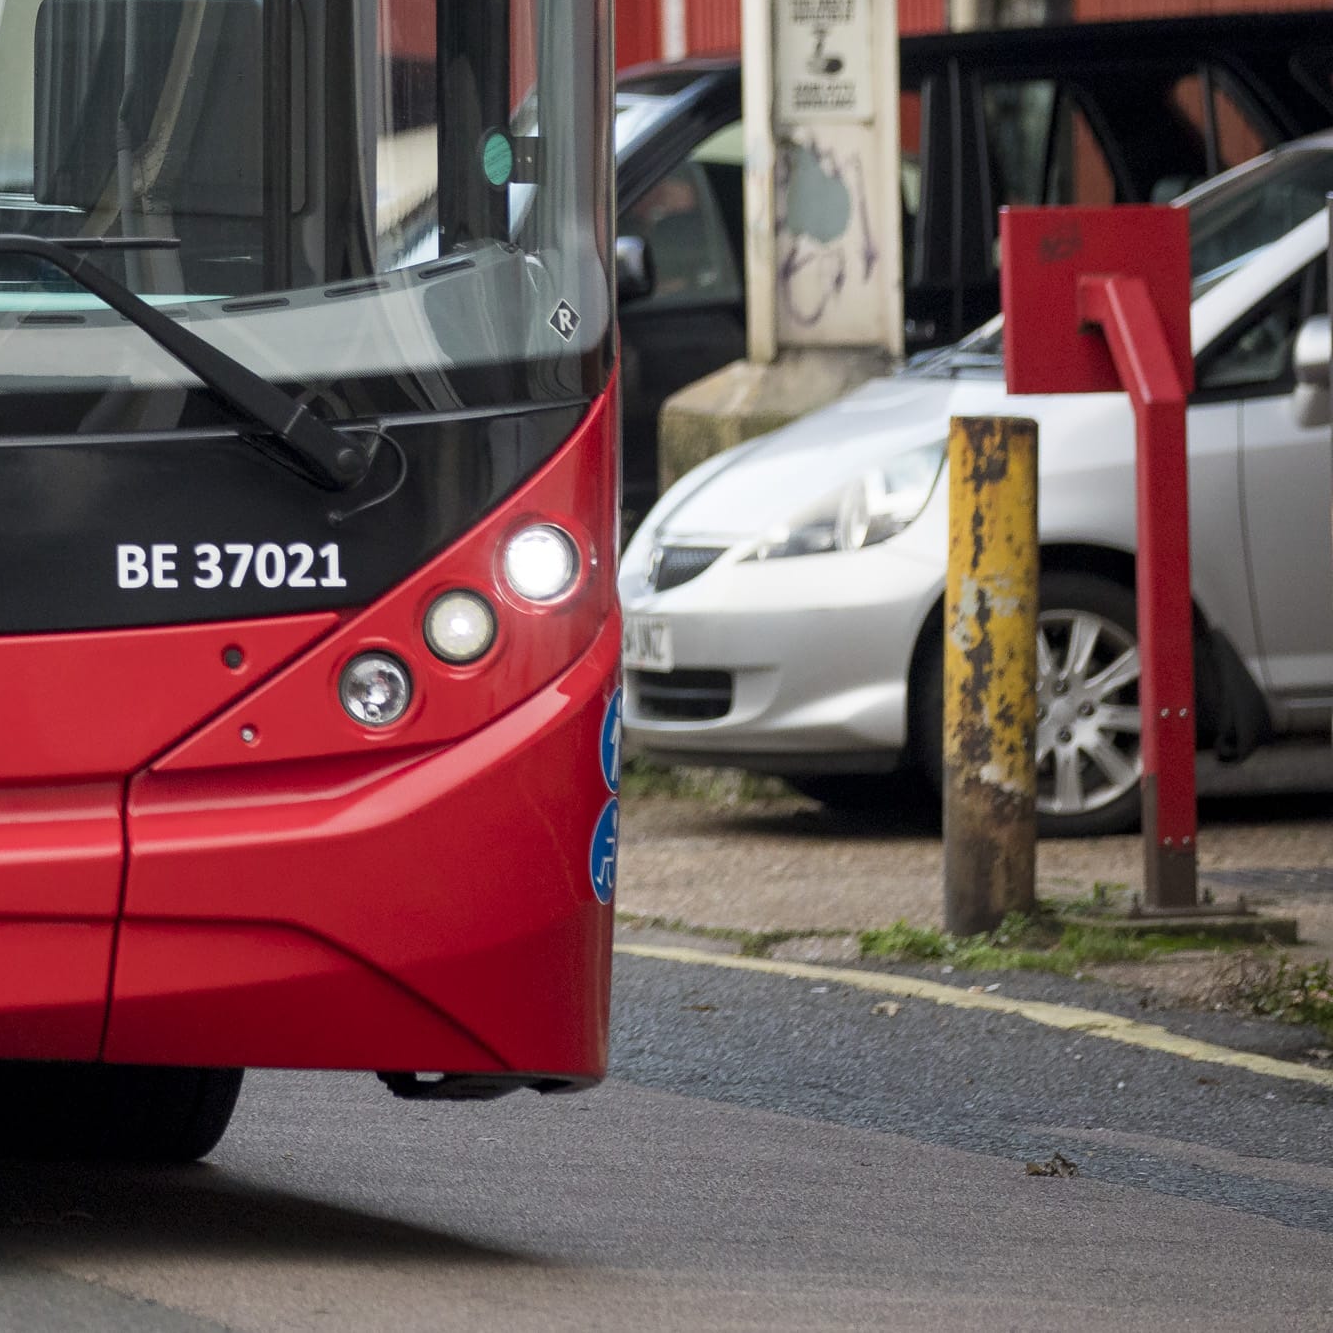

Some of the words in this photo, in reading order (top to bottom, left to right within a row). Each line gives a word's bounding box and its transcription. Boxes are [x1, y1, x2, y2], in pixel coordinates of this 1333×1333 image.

[558, 308, 574, 331] R
[117, 544, 178, 588] BE
[194, 543, 347, 588] 37021
